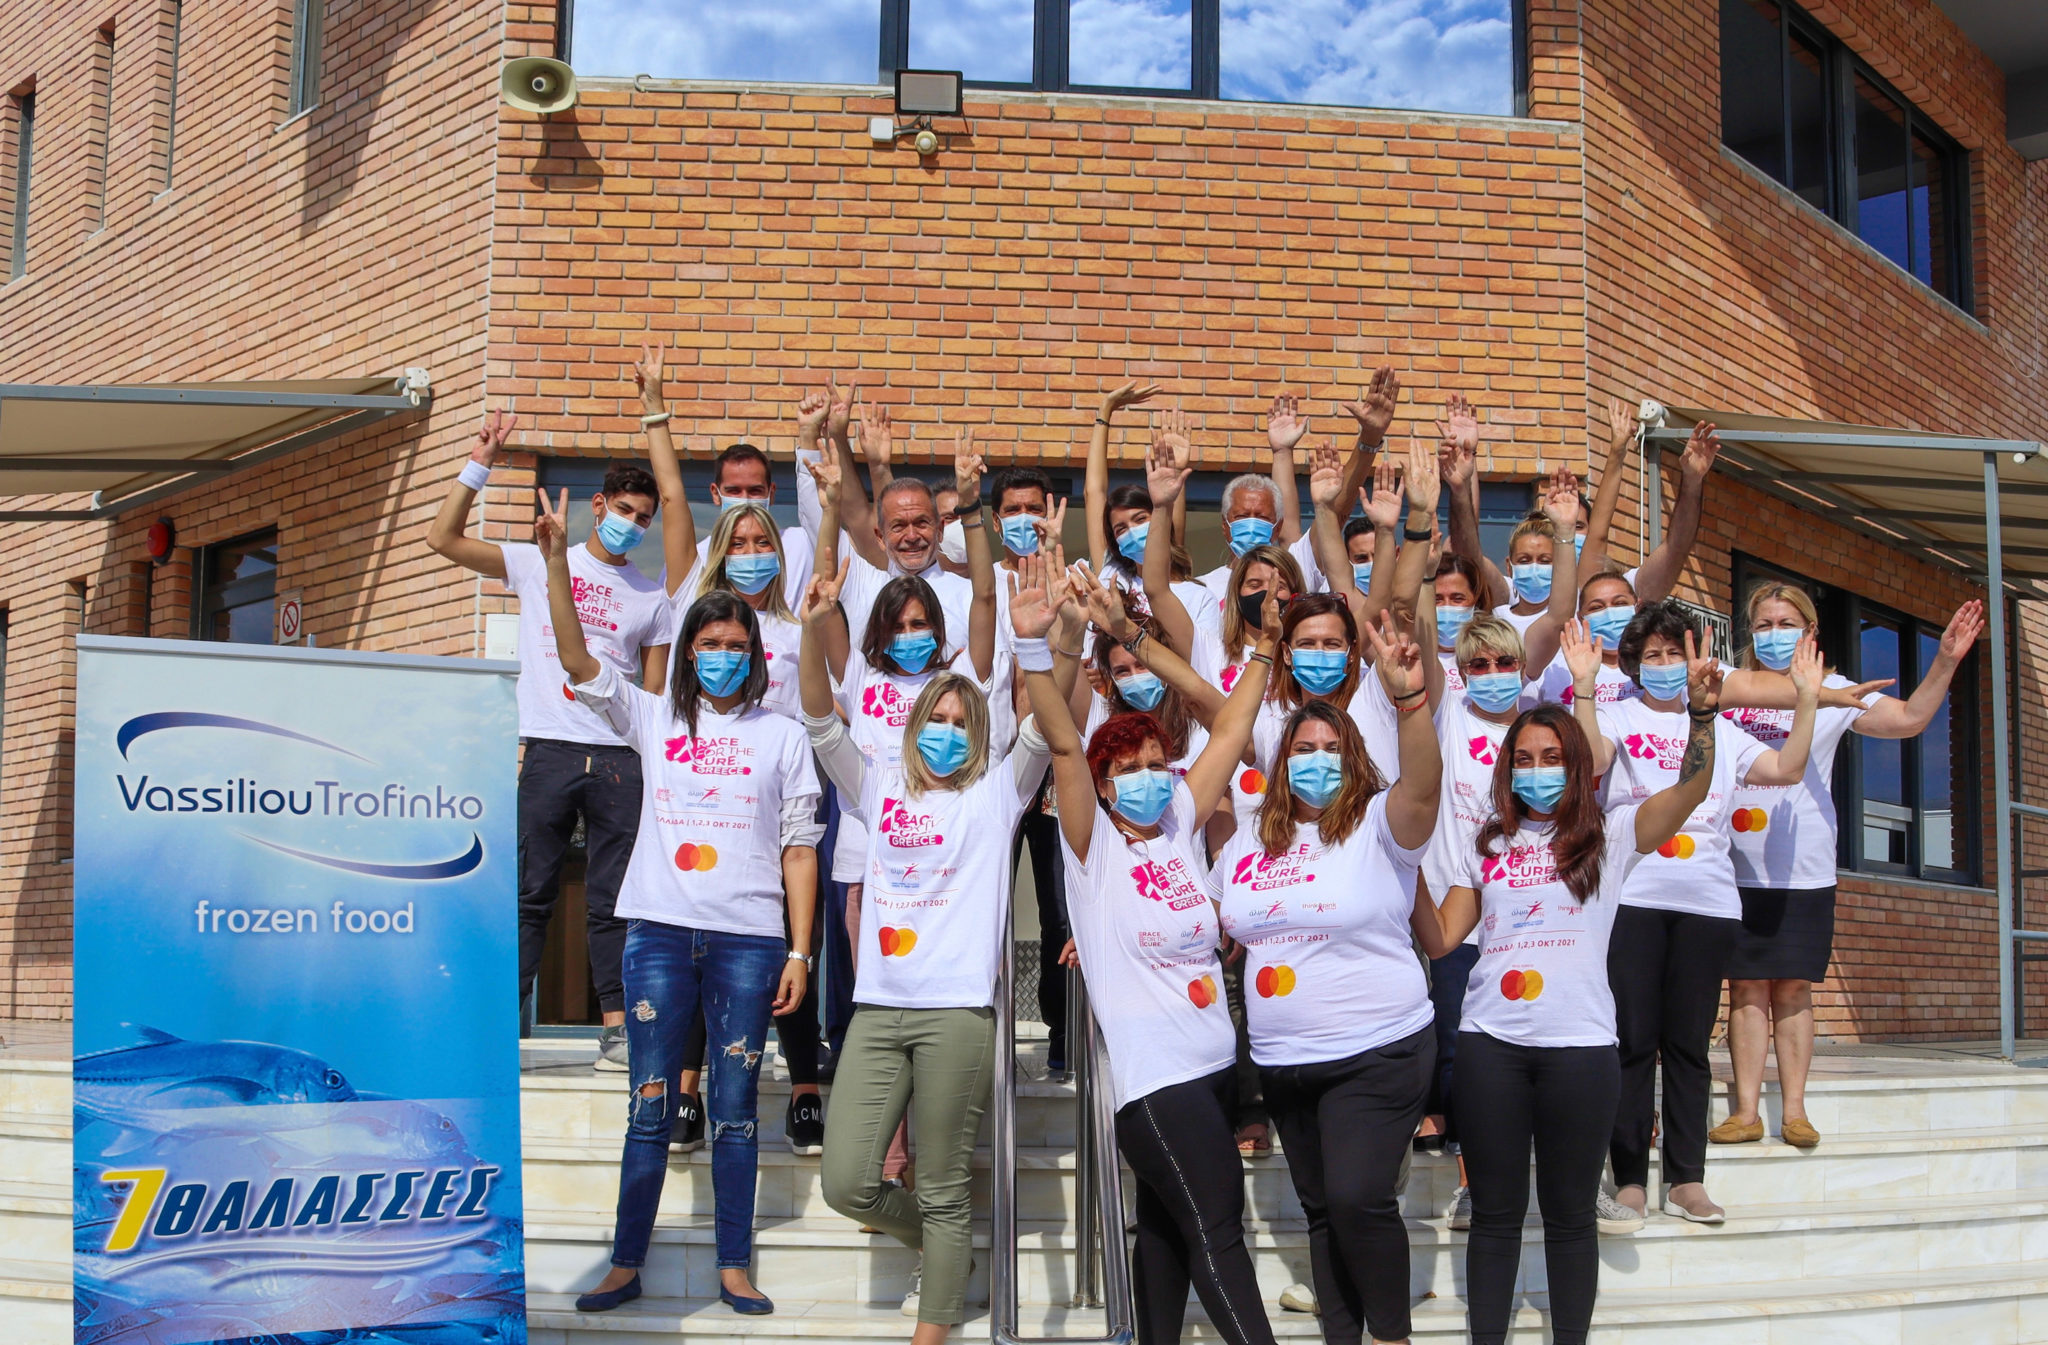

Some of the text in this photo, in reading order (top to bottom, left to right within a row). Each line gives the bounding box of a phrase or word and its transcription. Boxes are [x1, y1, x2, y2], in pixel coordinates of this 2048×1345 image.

[603, 597, 624, 612] THE
[1773, 712, 1795, 721] THE
[696, 737, 739, 748] RACE
[697, 746, 756, 757] FOR THE
[694, 755, 736, 765] CURE
[696, 766, 744, 775] GREECE
[116, 774, 484, 821] VassiliouTrofinko
[891, 835, 936, 846] GREECE
[1261, 856, 1292, 871] FOR
[1296, 850, 1321, 865] THE
[1255, 866, 1302, 880] CURE
[1509, 865, 1555, 878] CURE
[1255, 876, 1307, 890] GREECE
[1163, 880, 1197, 899] CURE
[930, 899, 948, 907] 2021
[194, 899, 415, 934] frozen food
[1307, 934, 1329, 942] 2021
[1518, 939, 1535, 949] 1,2,3
